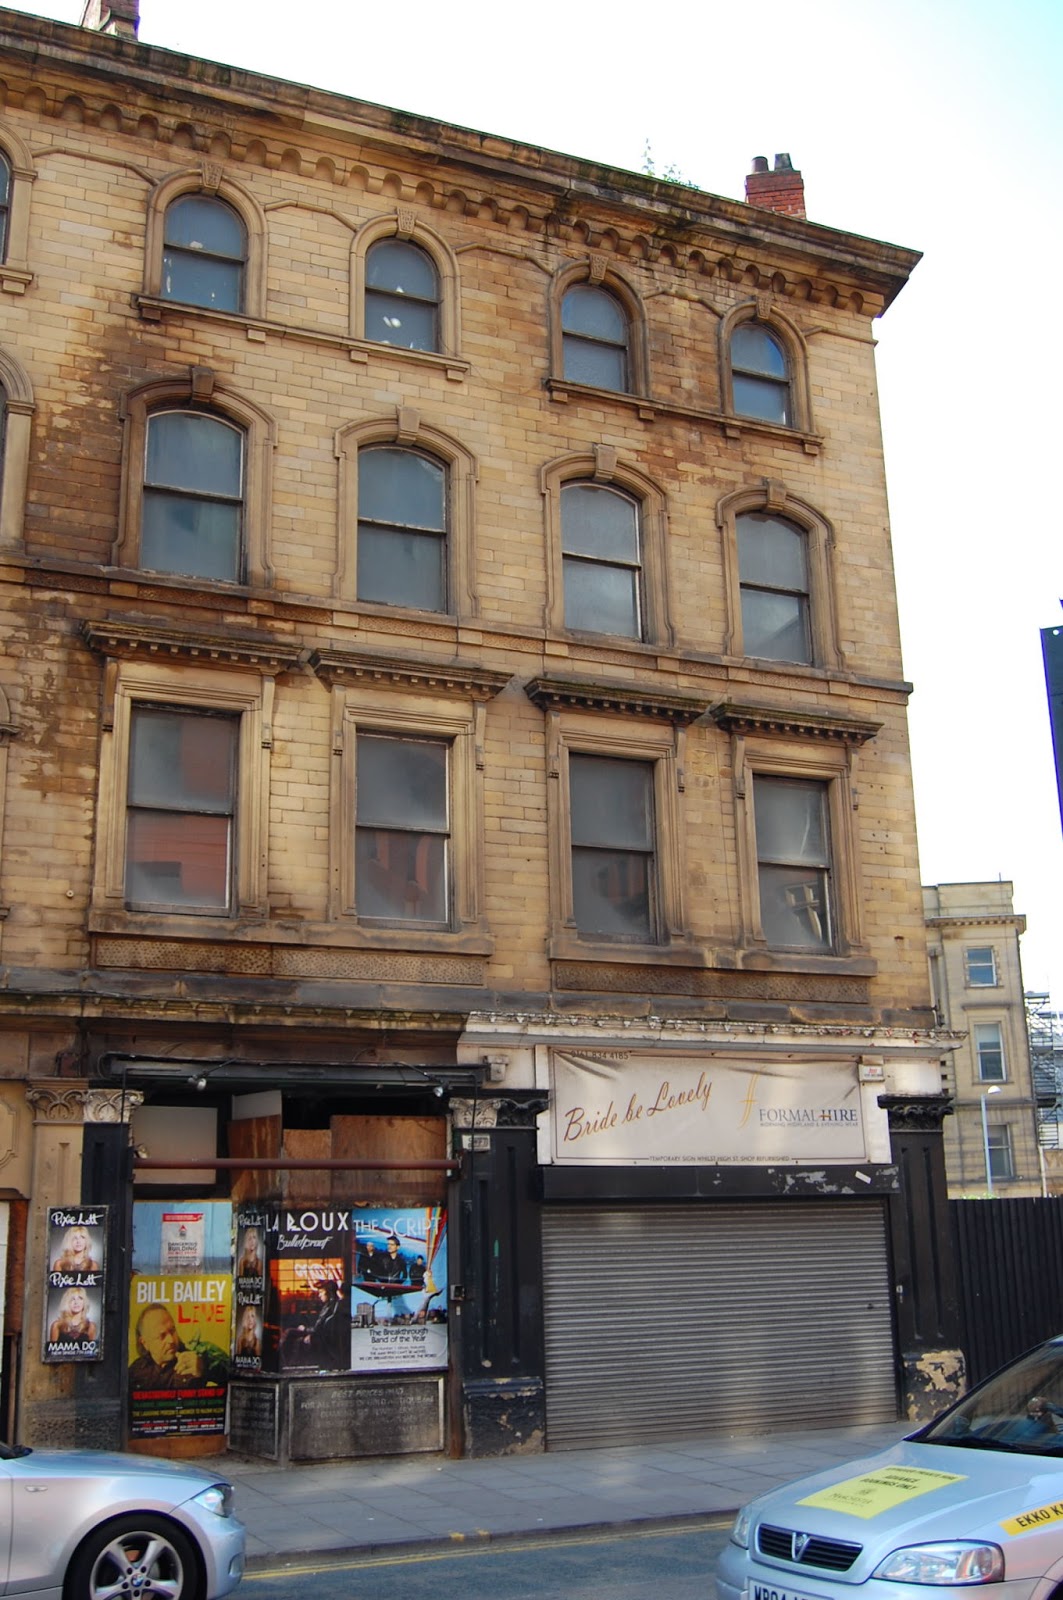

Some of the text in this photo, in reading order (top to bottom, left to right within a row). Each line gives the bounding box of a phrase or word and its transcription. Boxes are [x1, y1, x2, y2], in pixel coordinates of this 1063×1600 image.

[564, 1072, 712, 1142] Bride be Lovely
[760, 1108, 858, 1122] FORMAL HIRE
[51, 1211, 104, 1227] Pixie Lott
[266, 1212, 349, 1232] LA ROUX
[354, 1216, 442, 1237] THE SCRIPT
[277, 1234, 334, 1250] Bulletproof
[50, 1272, 102, 1288] Pixie Lott
[137, 1280, 226, 1303] BILL BAILEY
[178, 1304, 225, 1324] LIVE
[383, 1328, 429, 1336] Breakthrough
[48, 1342, 96, 1351] MAMA DO
[1016, 1509, 1050, 1527] EKKO
